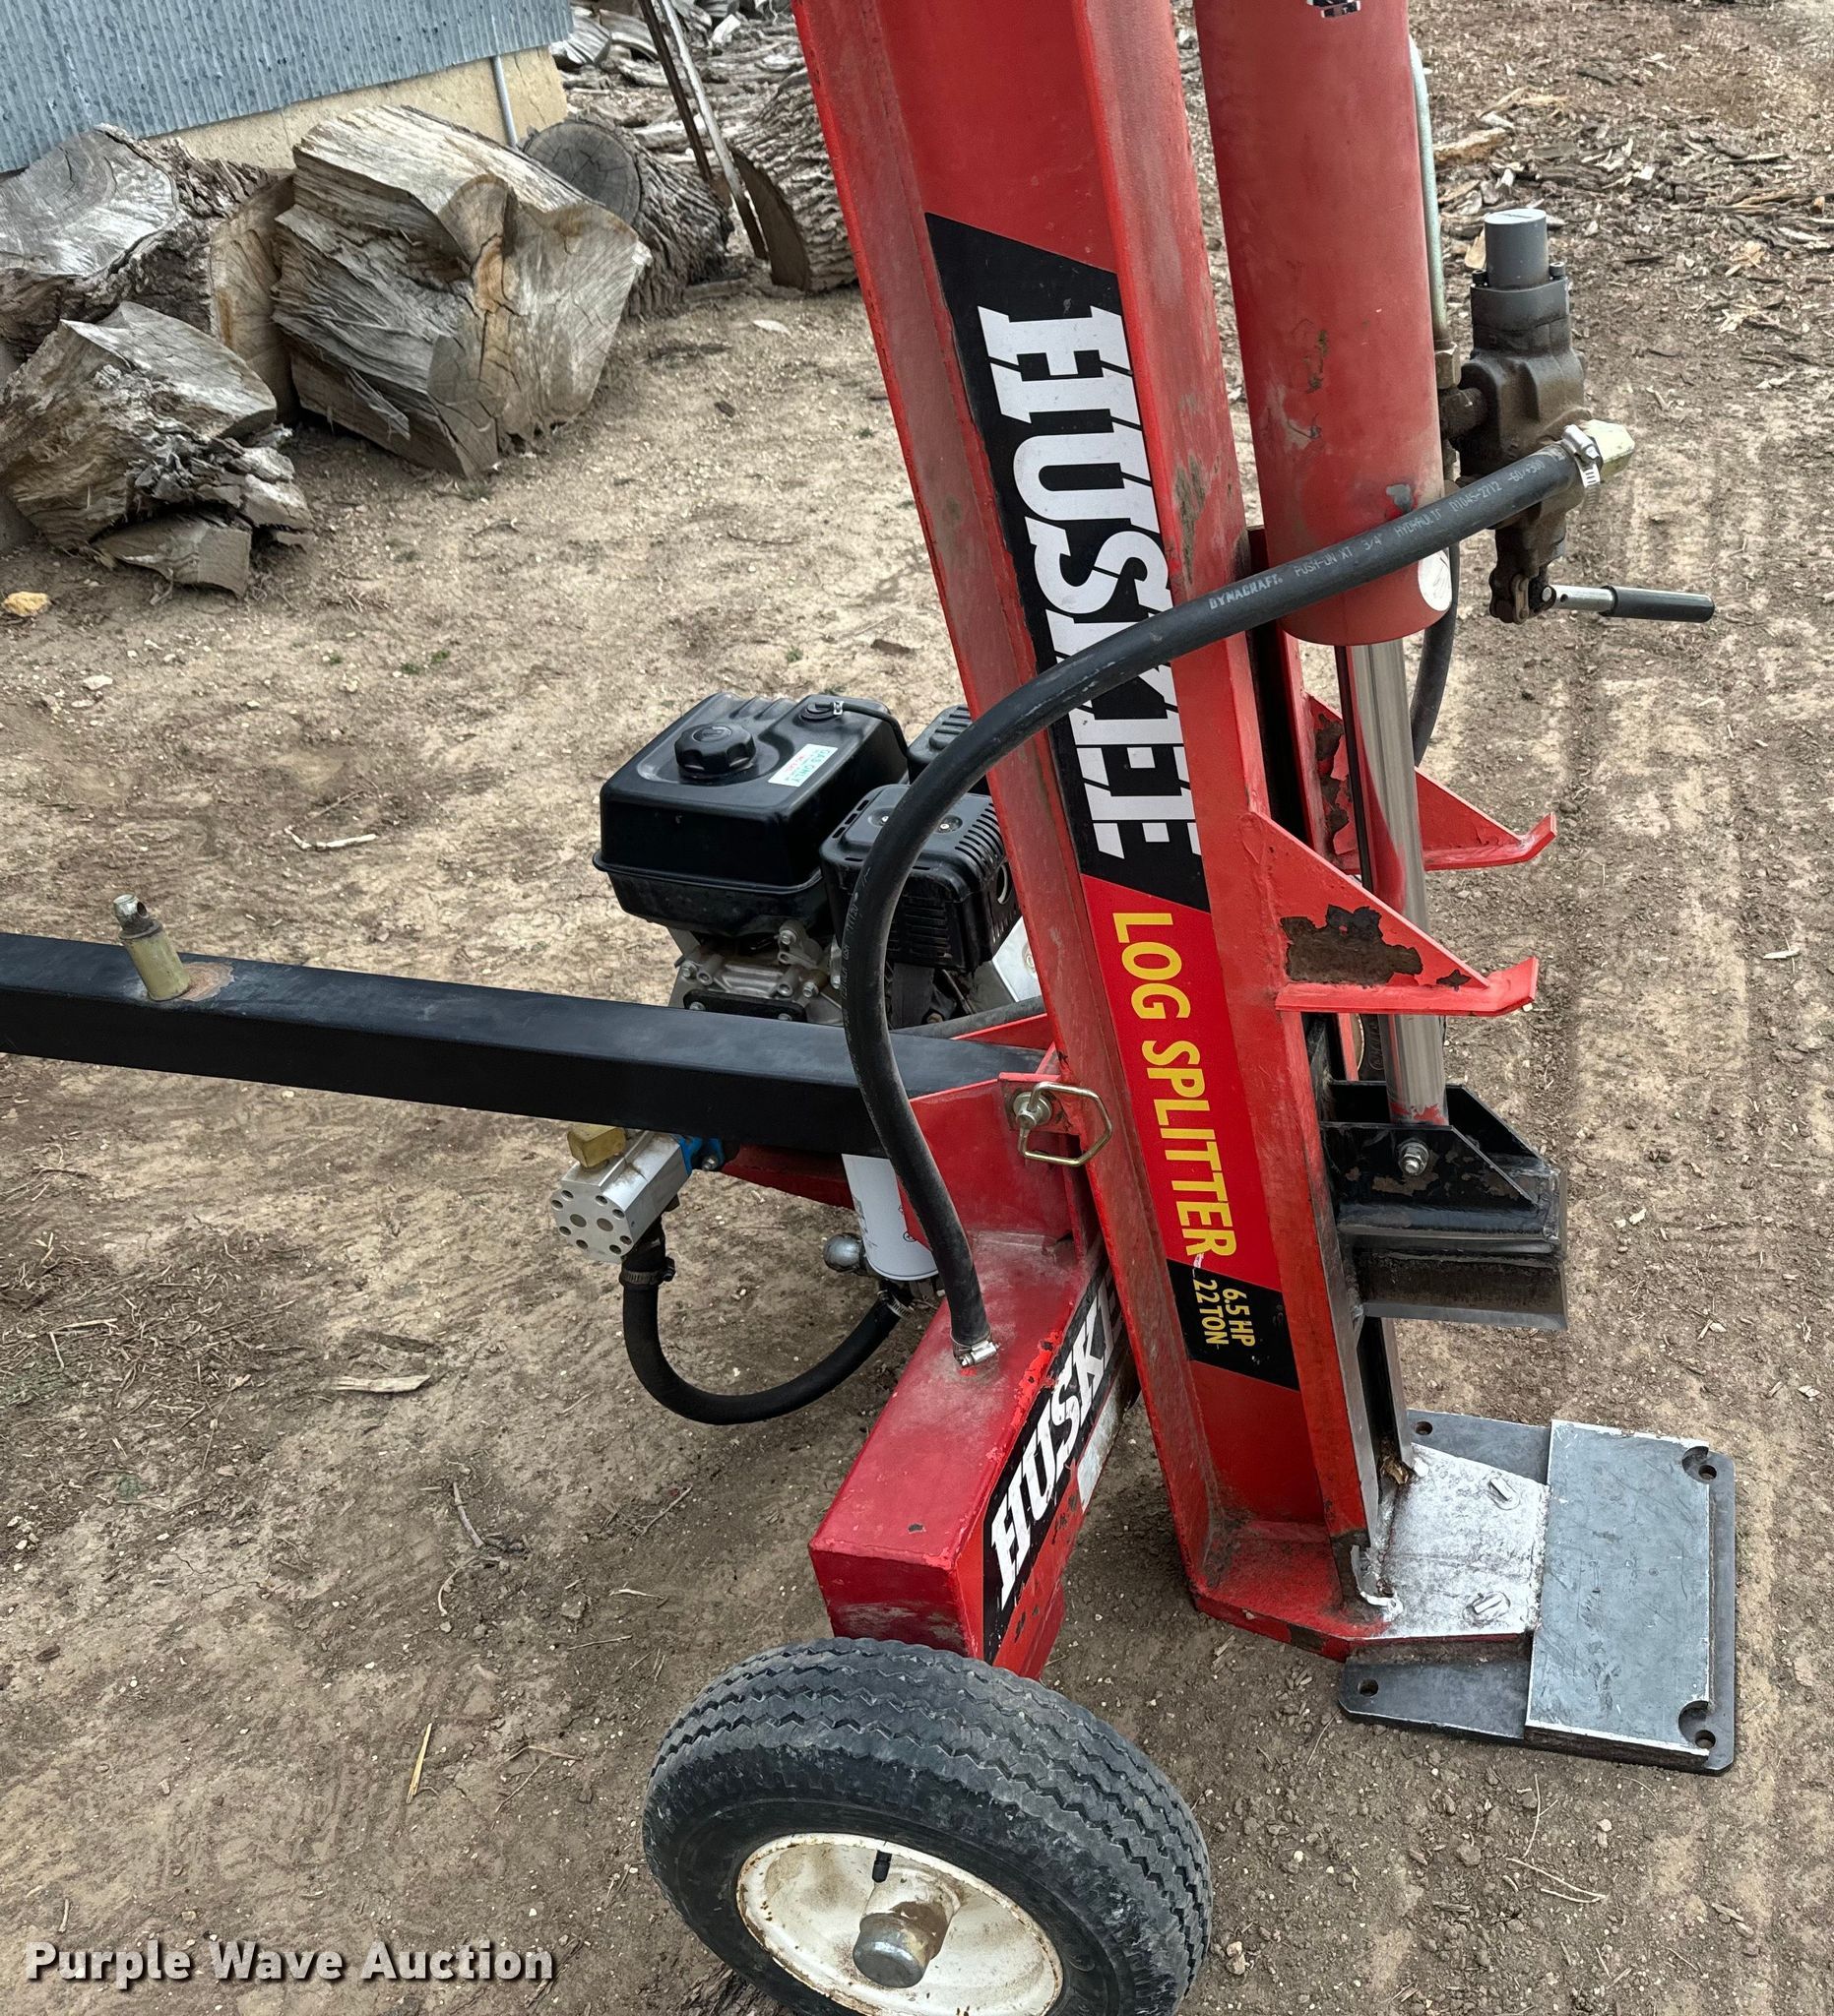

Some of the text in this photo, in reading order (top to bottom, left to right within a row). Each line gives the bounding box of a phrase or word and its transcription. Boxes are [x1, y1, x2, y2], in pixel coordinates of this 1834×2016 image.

[1339, 546, 1354, 560] XT
[1112, 912, 1237, 1257] LOG SPLITTER
[1192, 1279, 1230, 1345] 22 TON
[1222, 1288, 1256, 1347] 6.5 HP
